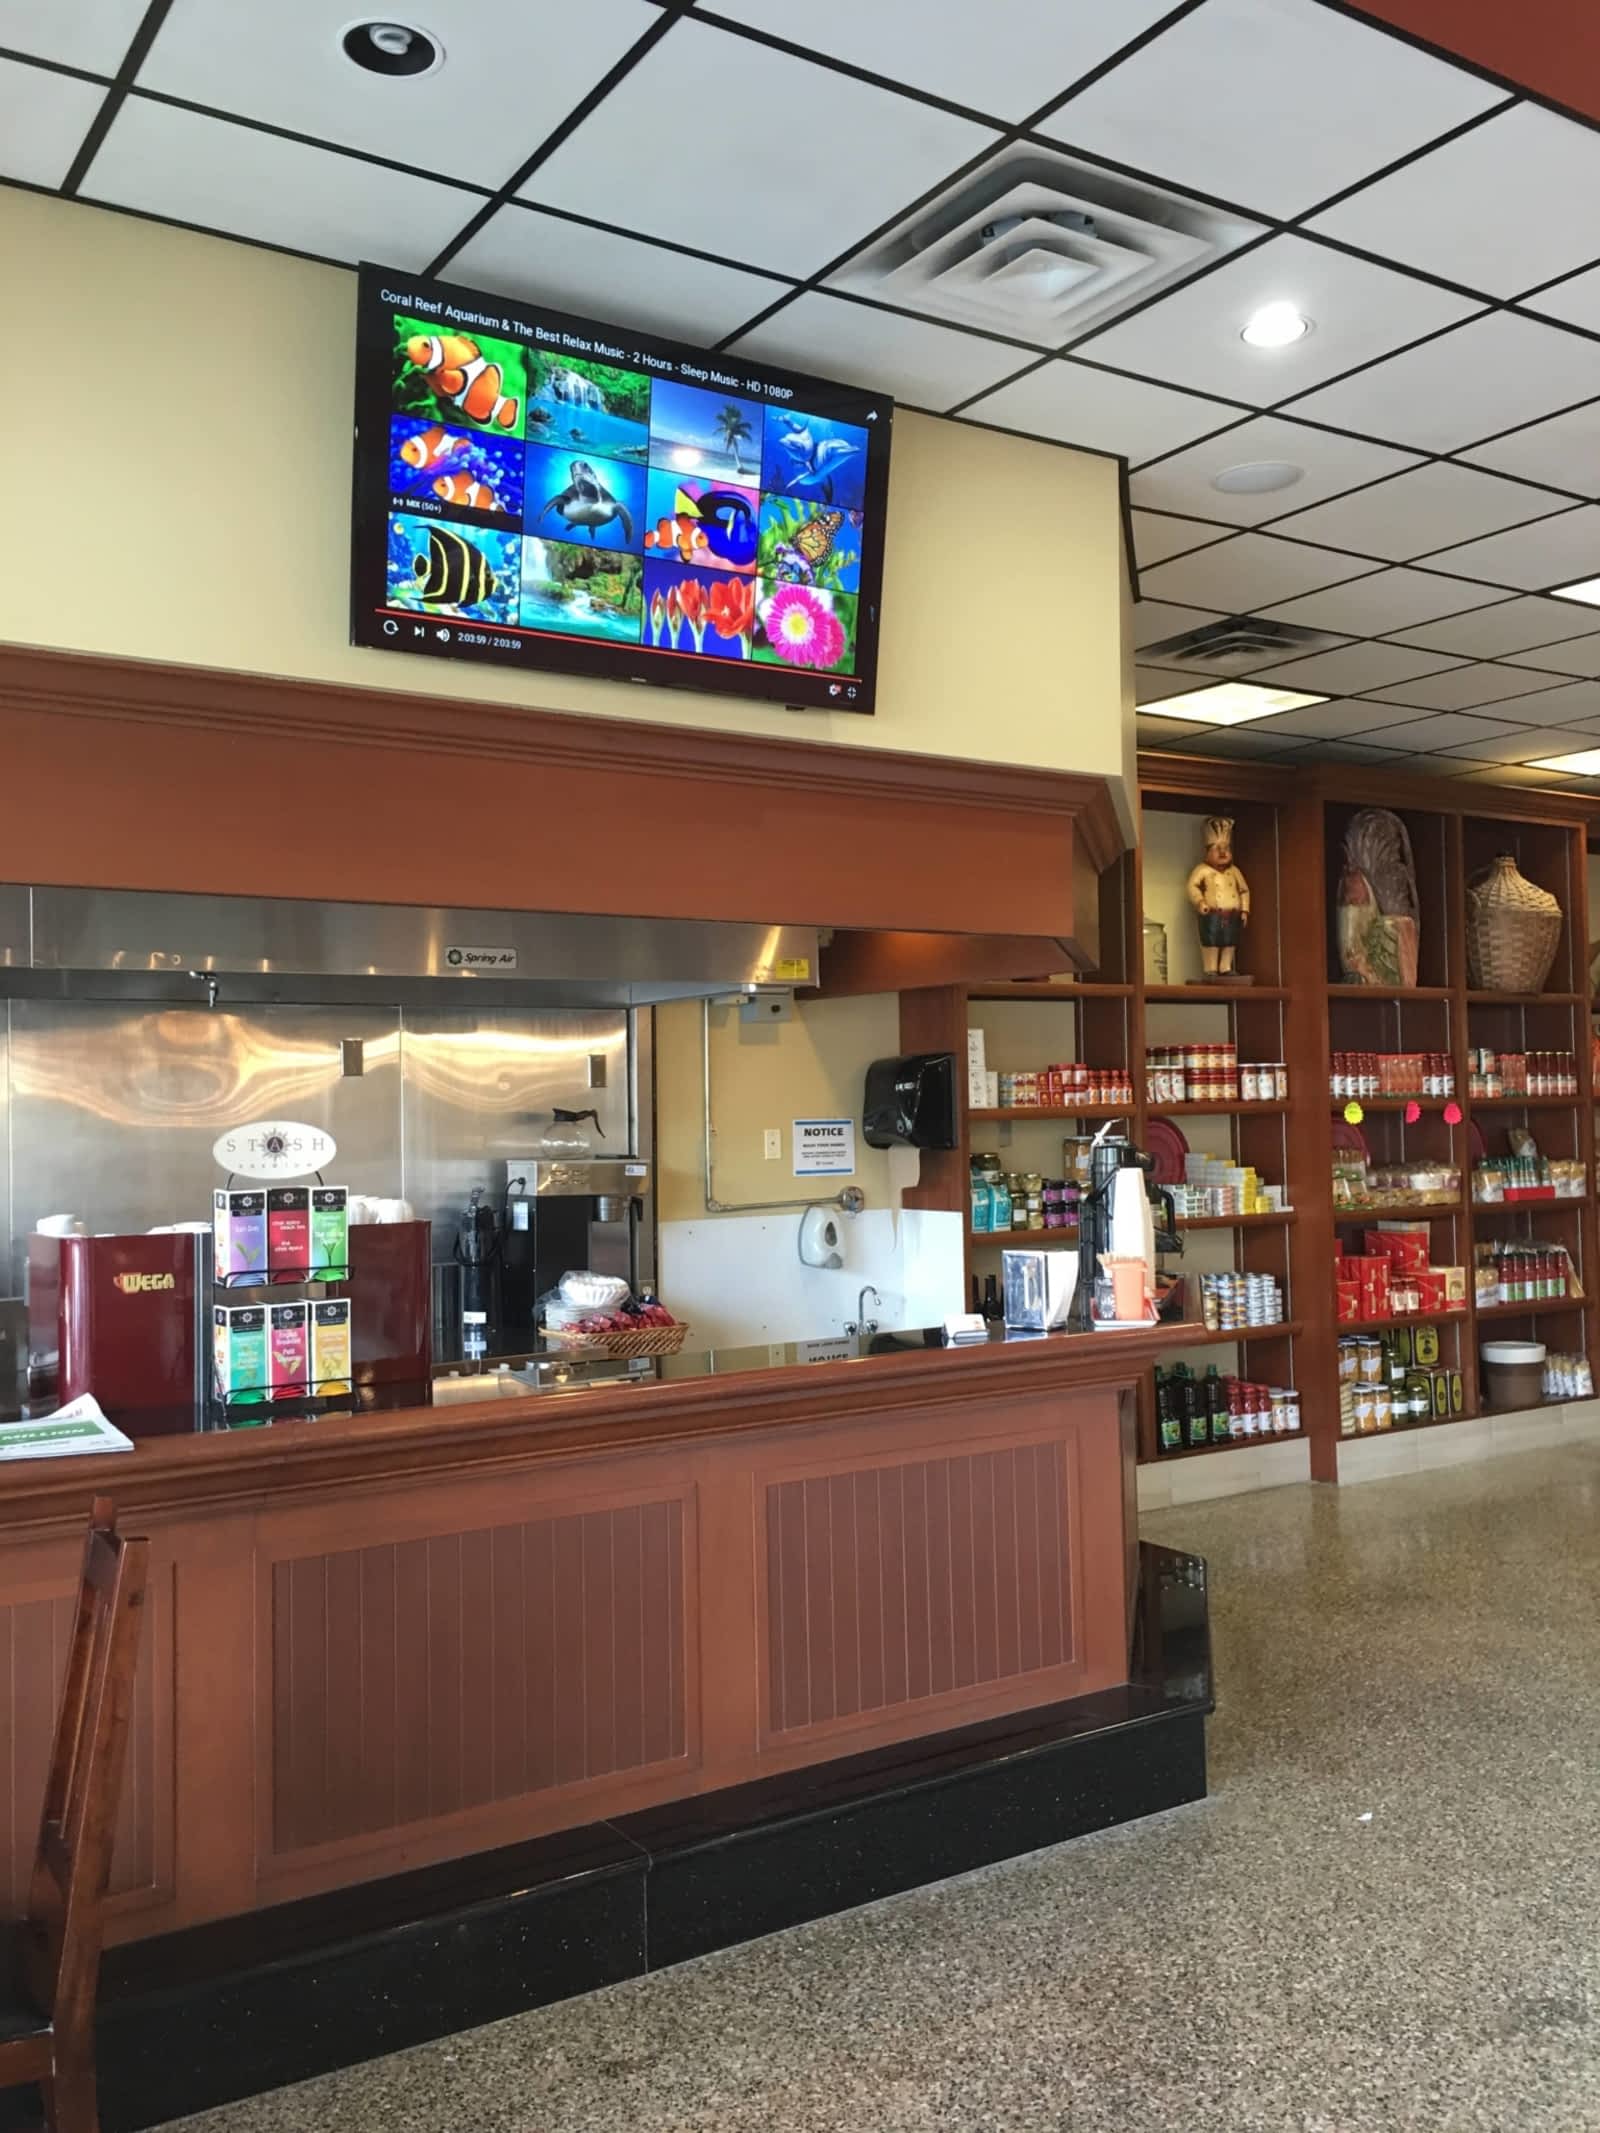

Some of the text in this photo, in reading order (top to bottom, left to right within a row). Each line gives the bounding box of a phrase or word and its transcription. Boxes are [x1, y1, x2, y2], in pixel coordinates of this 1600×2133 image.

[380, 289, 412, 307] Coral
[415, 297, 443, 314] Reef
[445, 305, 500, 330] Aquarium
[501, 319, 511, 331] &
[512, 321, 534, 337] The
[535, 327, 560, 344] Best
[562, 334, 592, 352] Relax
[594, 341, 625, 359] Music
[633, 353, 641, 363] 2
[642, 355, 673, 371] Hours
[681, 363, 708, 381] Sleep
[710, 371, 739, 387] Music
[746, 381, 761, 393] HD
[763, 384, 794, 400] 1080P
[464, 952, 515, 965] Spring Air
[804, 1127, 844, 1137] NOTICE
[226, 1136, 324, 1153] STASH
[122, 1272, 175, 1293] WEGA
